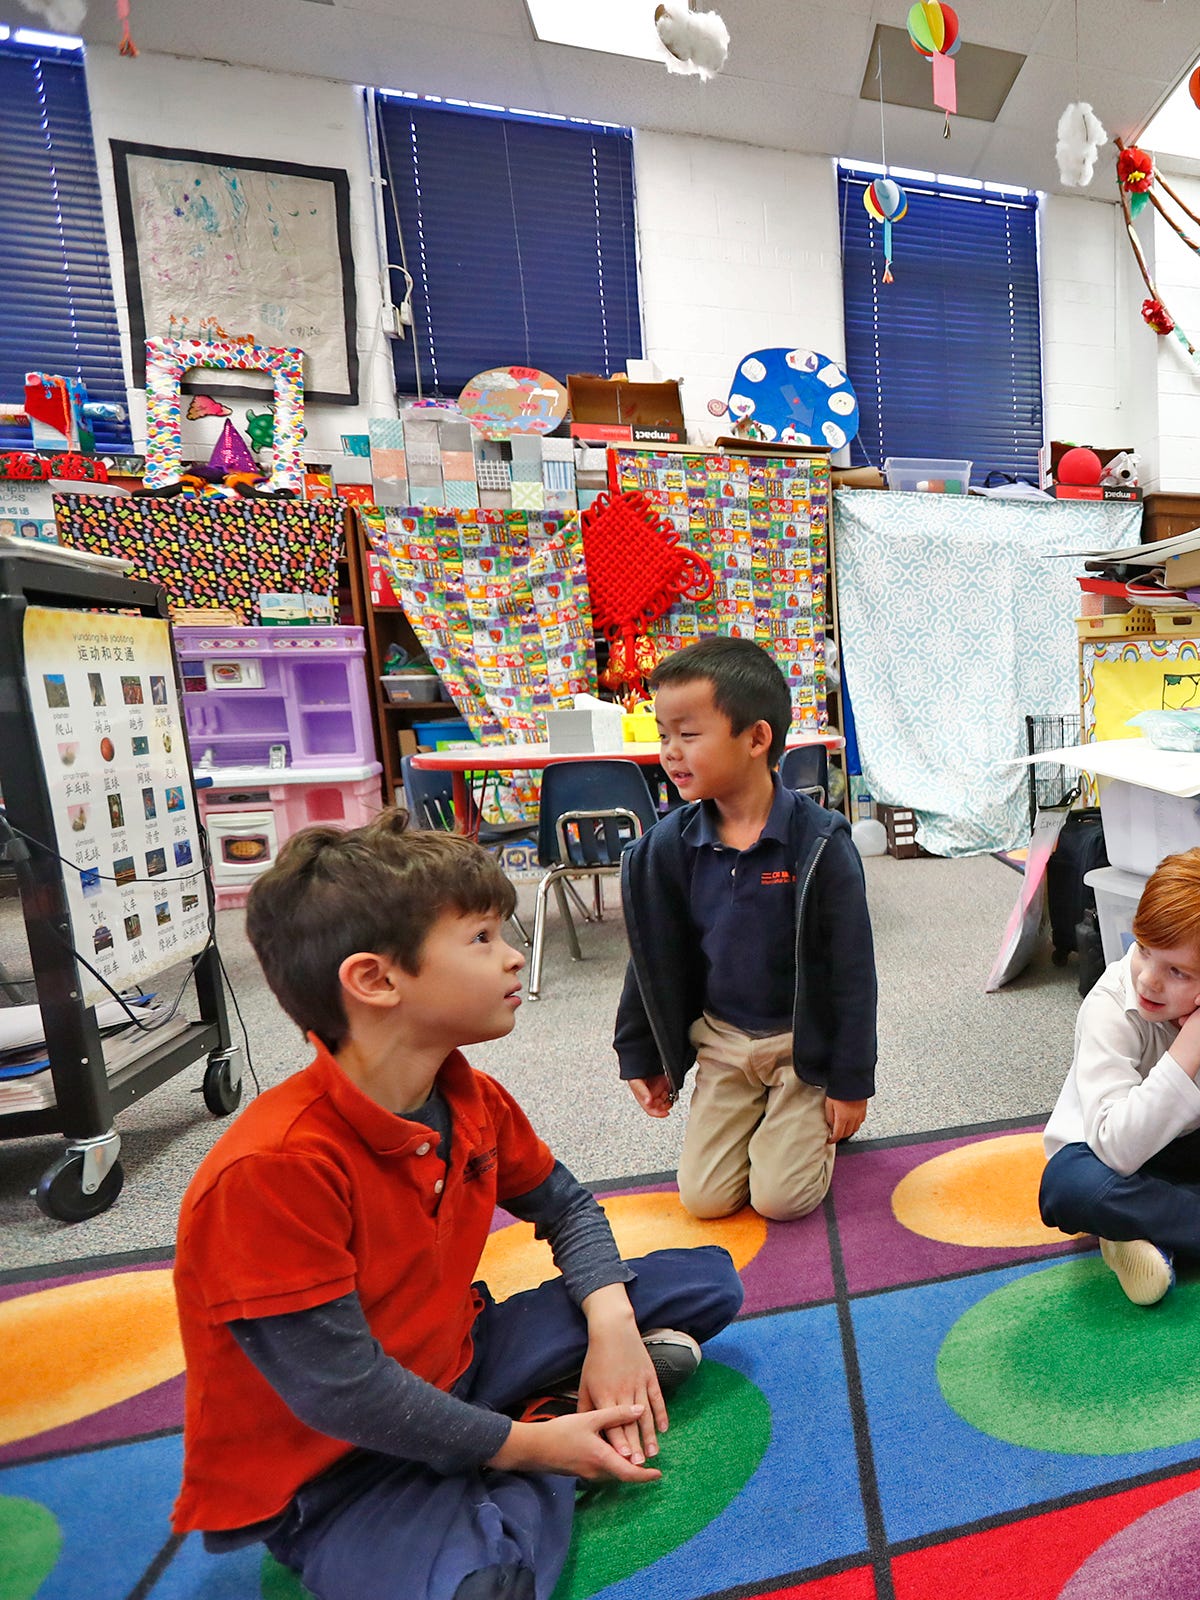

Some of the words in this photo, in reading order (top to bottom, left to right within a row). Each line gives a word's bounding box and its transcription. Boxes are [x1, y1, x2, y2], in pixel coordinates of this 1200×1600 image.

[635, 430, 670, 441] impact
[1104, 490, 1131, 499] impact
[77, 645, 135, 662] 运动和交通
[55, 722, 73, 736] 爬山
[129, 717, 145, 731] 跑步
[65, 781, 92, 797] 乒乓球
[104, 776, 121, 792] 篮球
[136, 771, 152, 785] 网球
[75, 846, 101, 864] 羽毛球
[89, 909, 107, 926] 飞机
[122, 898, 137, 914] 火车
[131, 947, 148, 965] 地铁
[183, 919, 207, 941] 公共汽车
